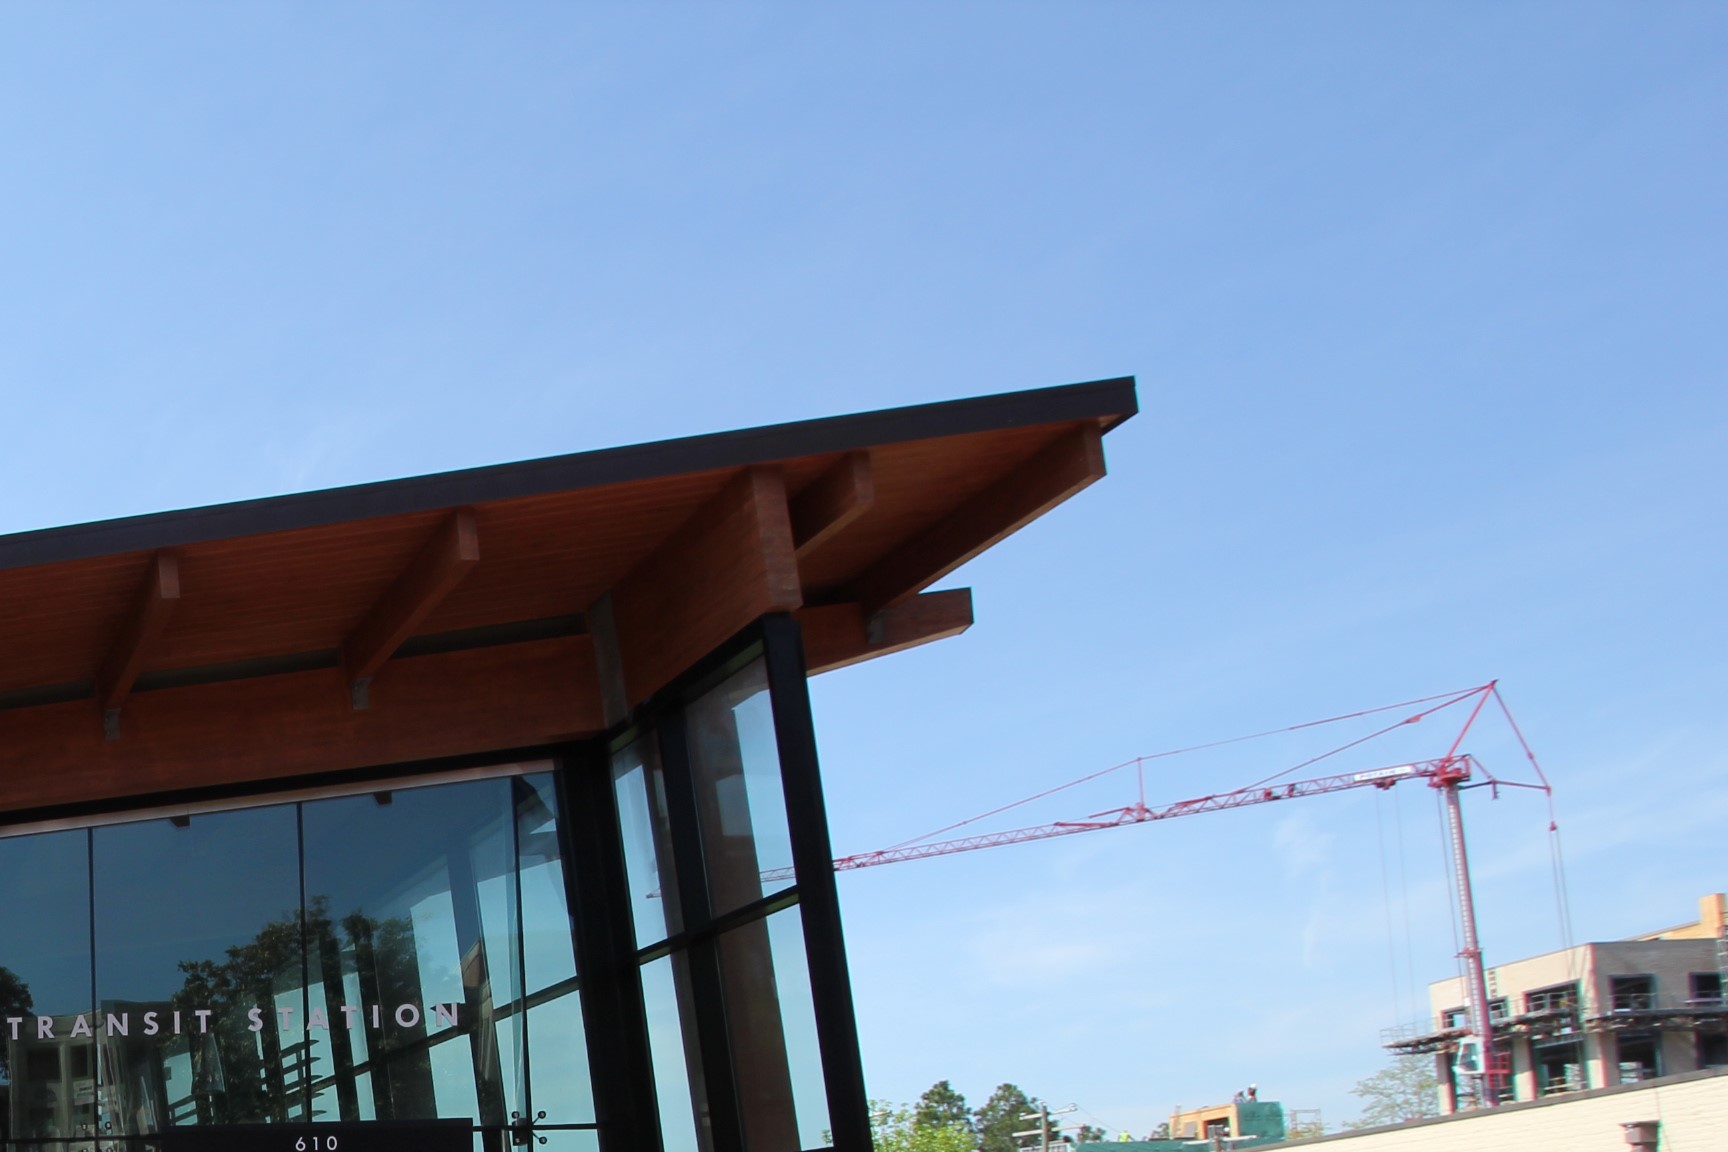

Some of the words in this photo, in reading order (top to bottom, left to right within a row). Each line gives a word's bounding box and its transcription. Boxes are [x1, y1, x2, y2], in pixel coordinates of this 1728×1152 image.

[6, 1009, 212, 1040] TRANSIT
[247, 1002, 459, 1032] STATION
[295, 1135, 338, 1151] 610
